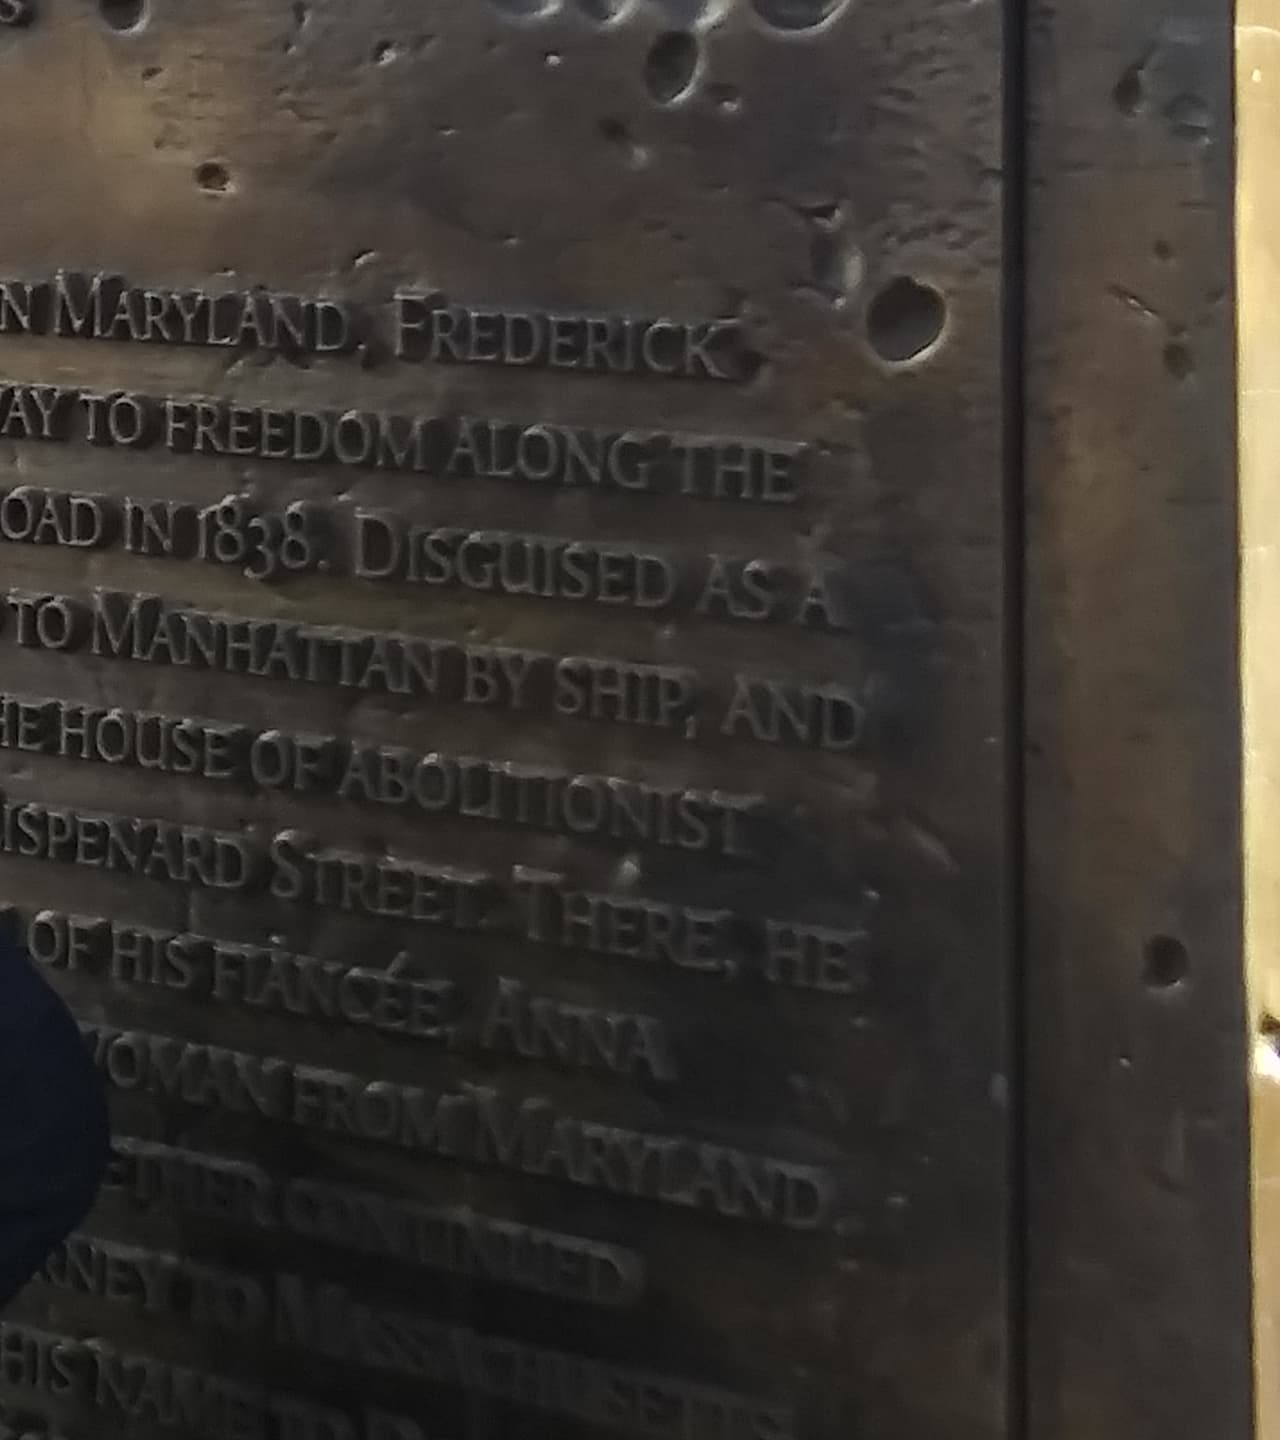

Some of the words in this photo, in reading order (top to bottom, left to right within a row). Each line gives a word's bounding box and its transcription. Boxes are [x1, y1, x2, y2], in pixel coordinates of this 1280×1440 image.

[393, 289, 735, 380] FREDERICK
[82, 391, 146, 446] TO
[163, 395, 432, 470] FREEDOM
[446, 422, 650, 491] ALONG
[670, 432, 802, 503] THE
[123, 498, 175, 553] IN
[196, 494, 328, 581] 1838.
[352, 506, 676, 609] DISGUISED
[694, 553, 772, 621] AS
[795, 563, 844, 629] A
[9, 588, 74, 652] TO
[90, 588, 440, 695] MANHATTAN
[464, 646, 534, 707] BY
[555, 656, 698, 740] SHIP,
[720, 678, 868, 750] AND
[58, 708, 235, 779] HOUSE
[250, 730, 336, 788] OF
[340, 750, 760, 855] ABOLITIONIST
[512, 865, 737, 982] THERE,
[27, 909, 106, 970] OF
[111, 929, 196, 987] HIS
[480, 975, 680, 1082] ANNA
[292, 1060, 450, 1158] FROM
